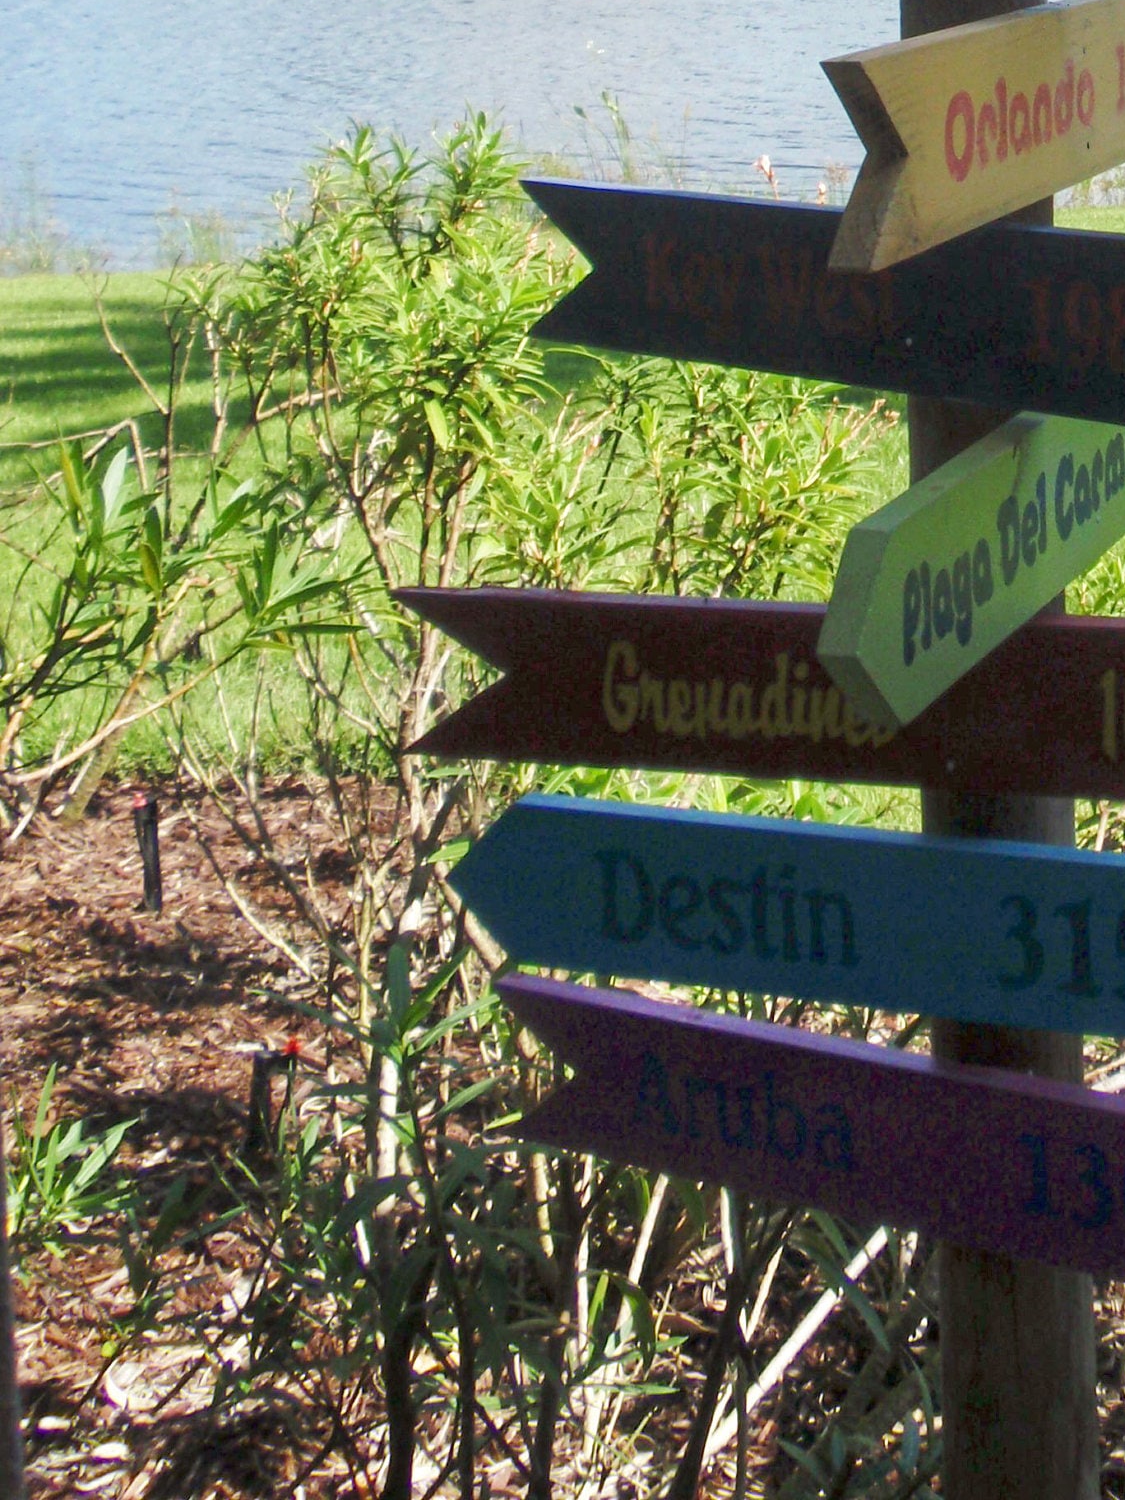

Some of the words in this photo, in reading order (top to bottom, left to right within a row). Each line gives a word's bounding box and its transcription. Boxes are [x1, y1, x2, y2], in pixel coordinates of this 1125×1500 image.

[944, 57, 1095, 182] Orlando
[643, 231, 745, 342] Key
[757, 242, 895, 338] West
[997, 496, 1047, 587] Del
[595, 848, 858, 969] Destin
[631, 1049, 856, 1173] Aruba
